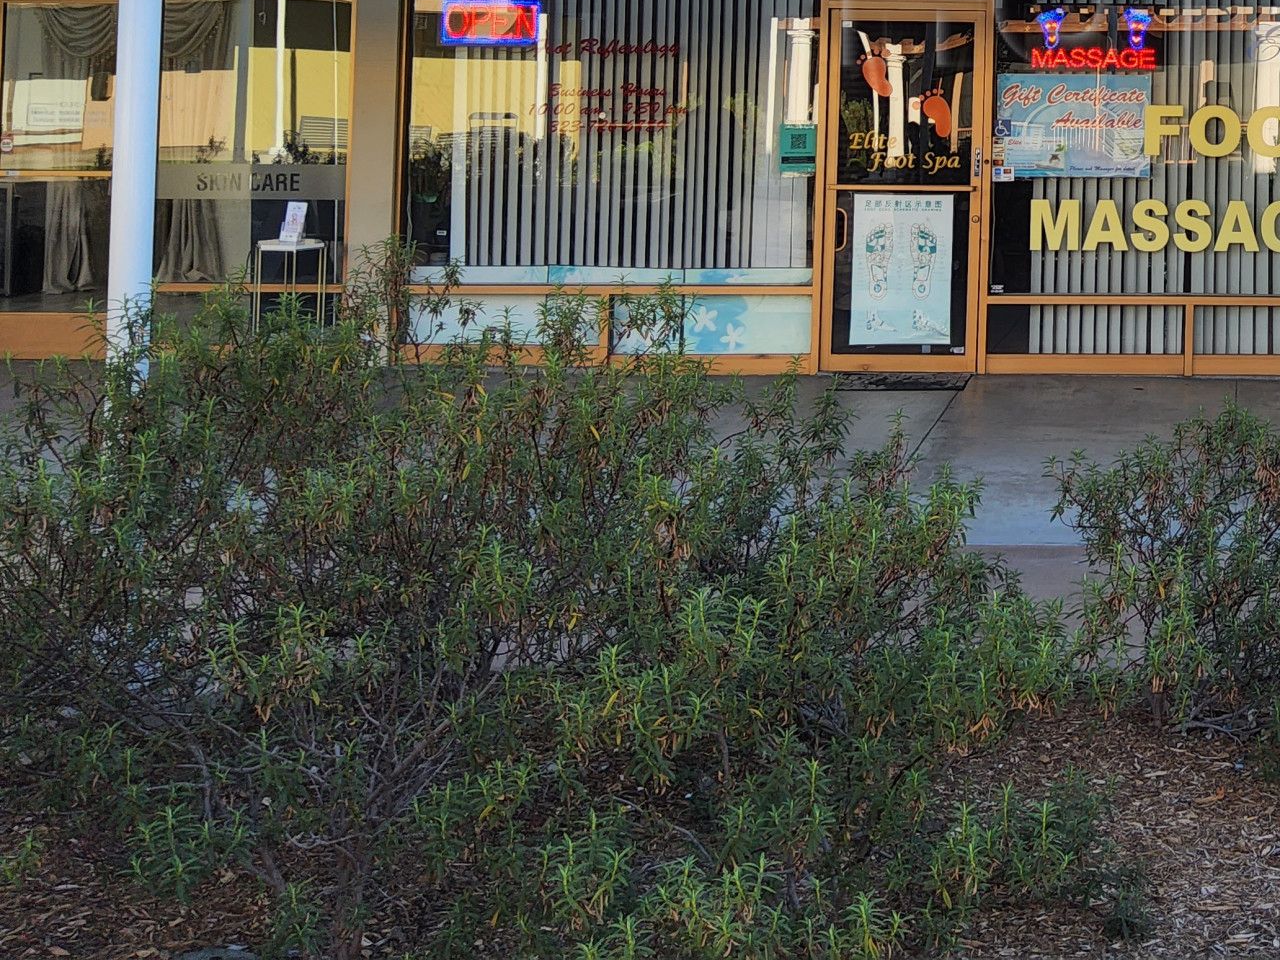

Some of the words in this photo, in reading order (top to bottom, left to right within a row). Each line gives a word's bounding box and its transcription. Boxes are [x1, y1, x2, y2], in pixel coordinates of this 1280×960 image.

[446, 4, 538, 39] OPEN
[1030, 48, 1156, 69] MASSAGE
[549, 83, 612, 97] Business
[1002, 82, 1042, 108] Gift
[1047, 82, 1147, 107] Certificate
[1052, 111, 1145, 130] Available
[849, 130, 898, 149] Elite
[867, 151, 917, 172] Foot
[922, 151, 961, 175] Spa
[197, 173, 242, 192] SKIN
[251, 173, 300, 192] CARE
